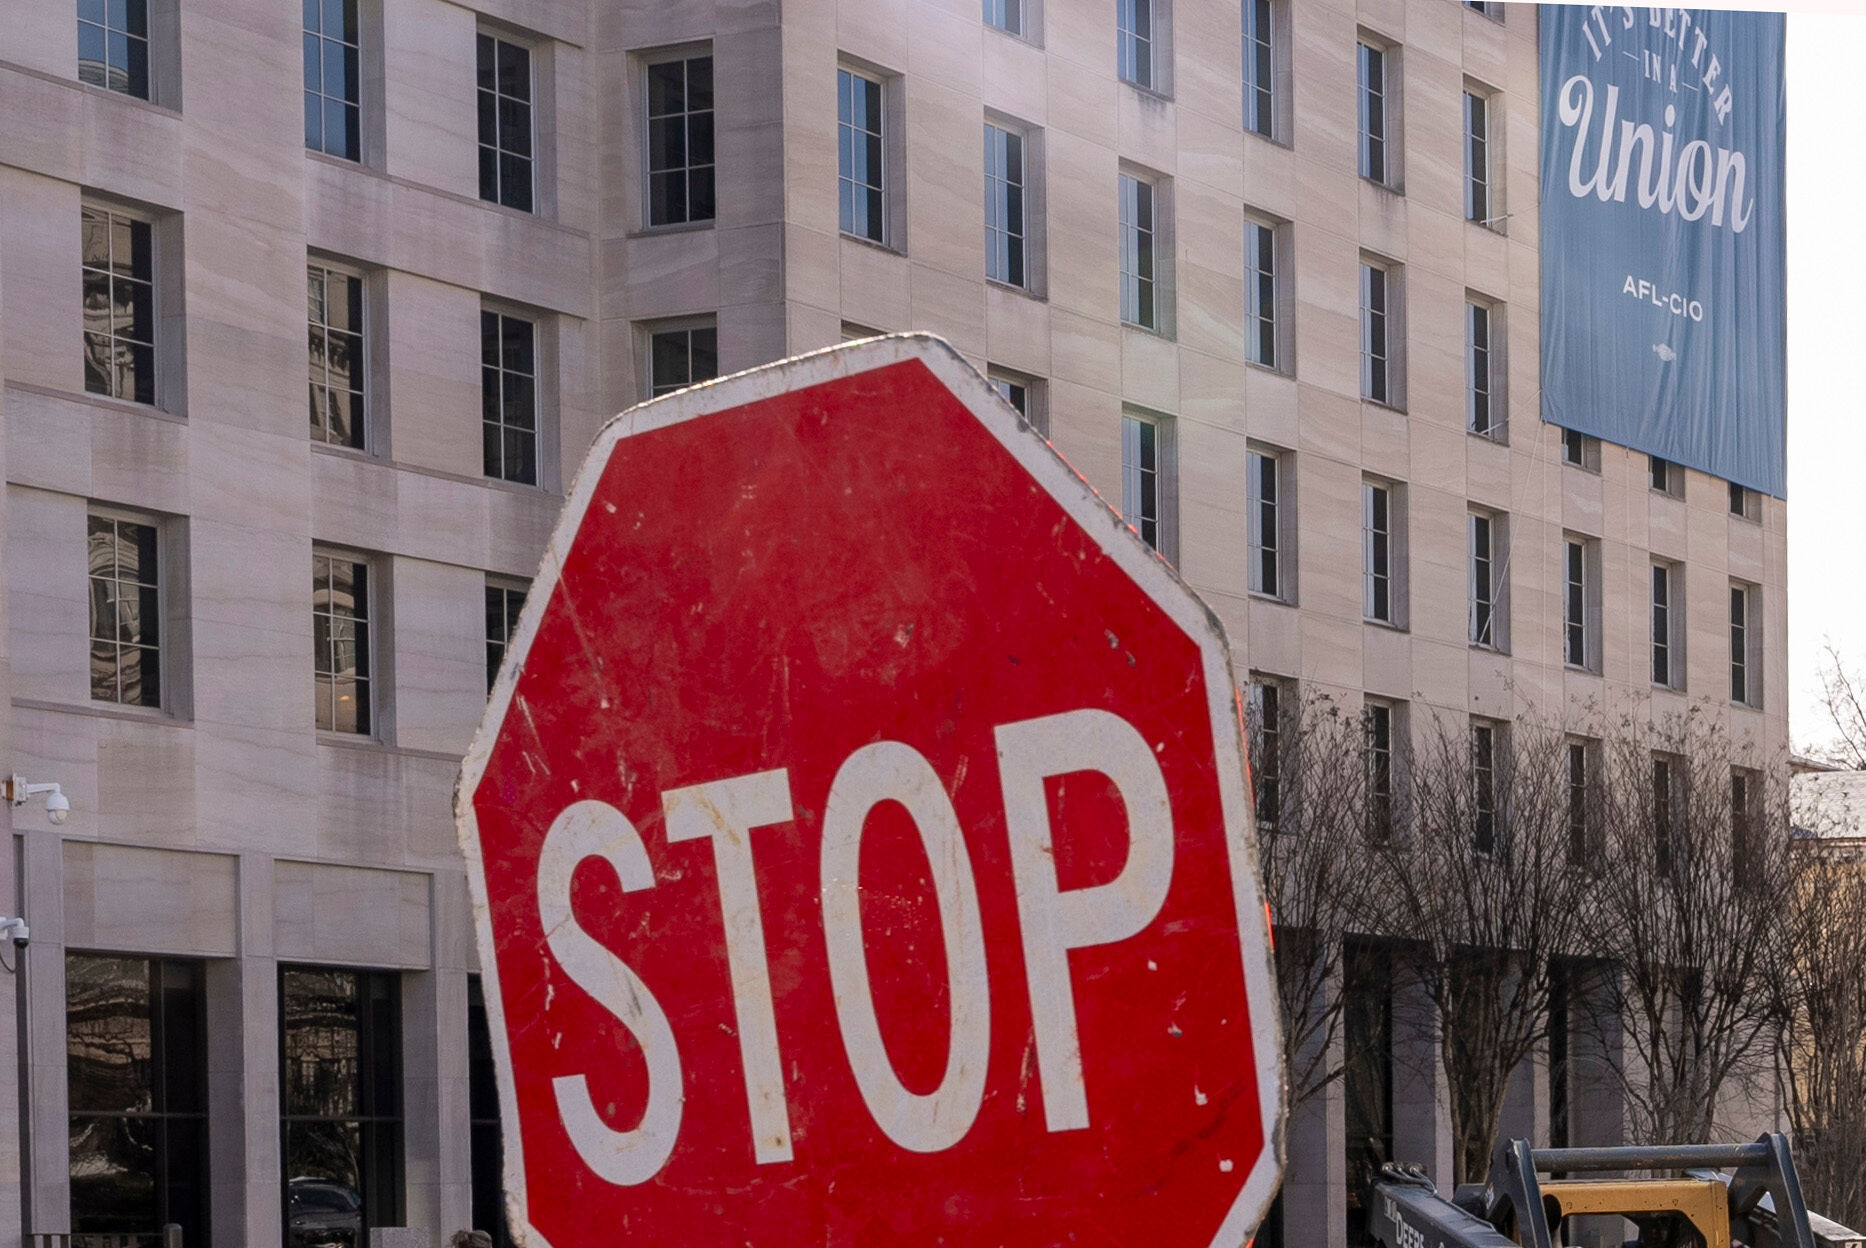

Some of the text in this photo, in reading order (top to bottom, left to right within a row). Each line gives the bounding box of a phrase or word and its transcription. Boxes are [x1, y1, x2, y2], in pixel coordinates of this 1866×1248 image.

[1643, 49, 1678, 93] IN A
[1558, 75, 1754, 233] Union
[1623, 274, 1704, 322] AFL-CIO
[537, 708, 1175, 1186] STOP
